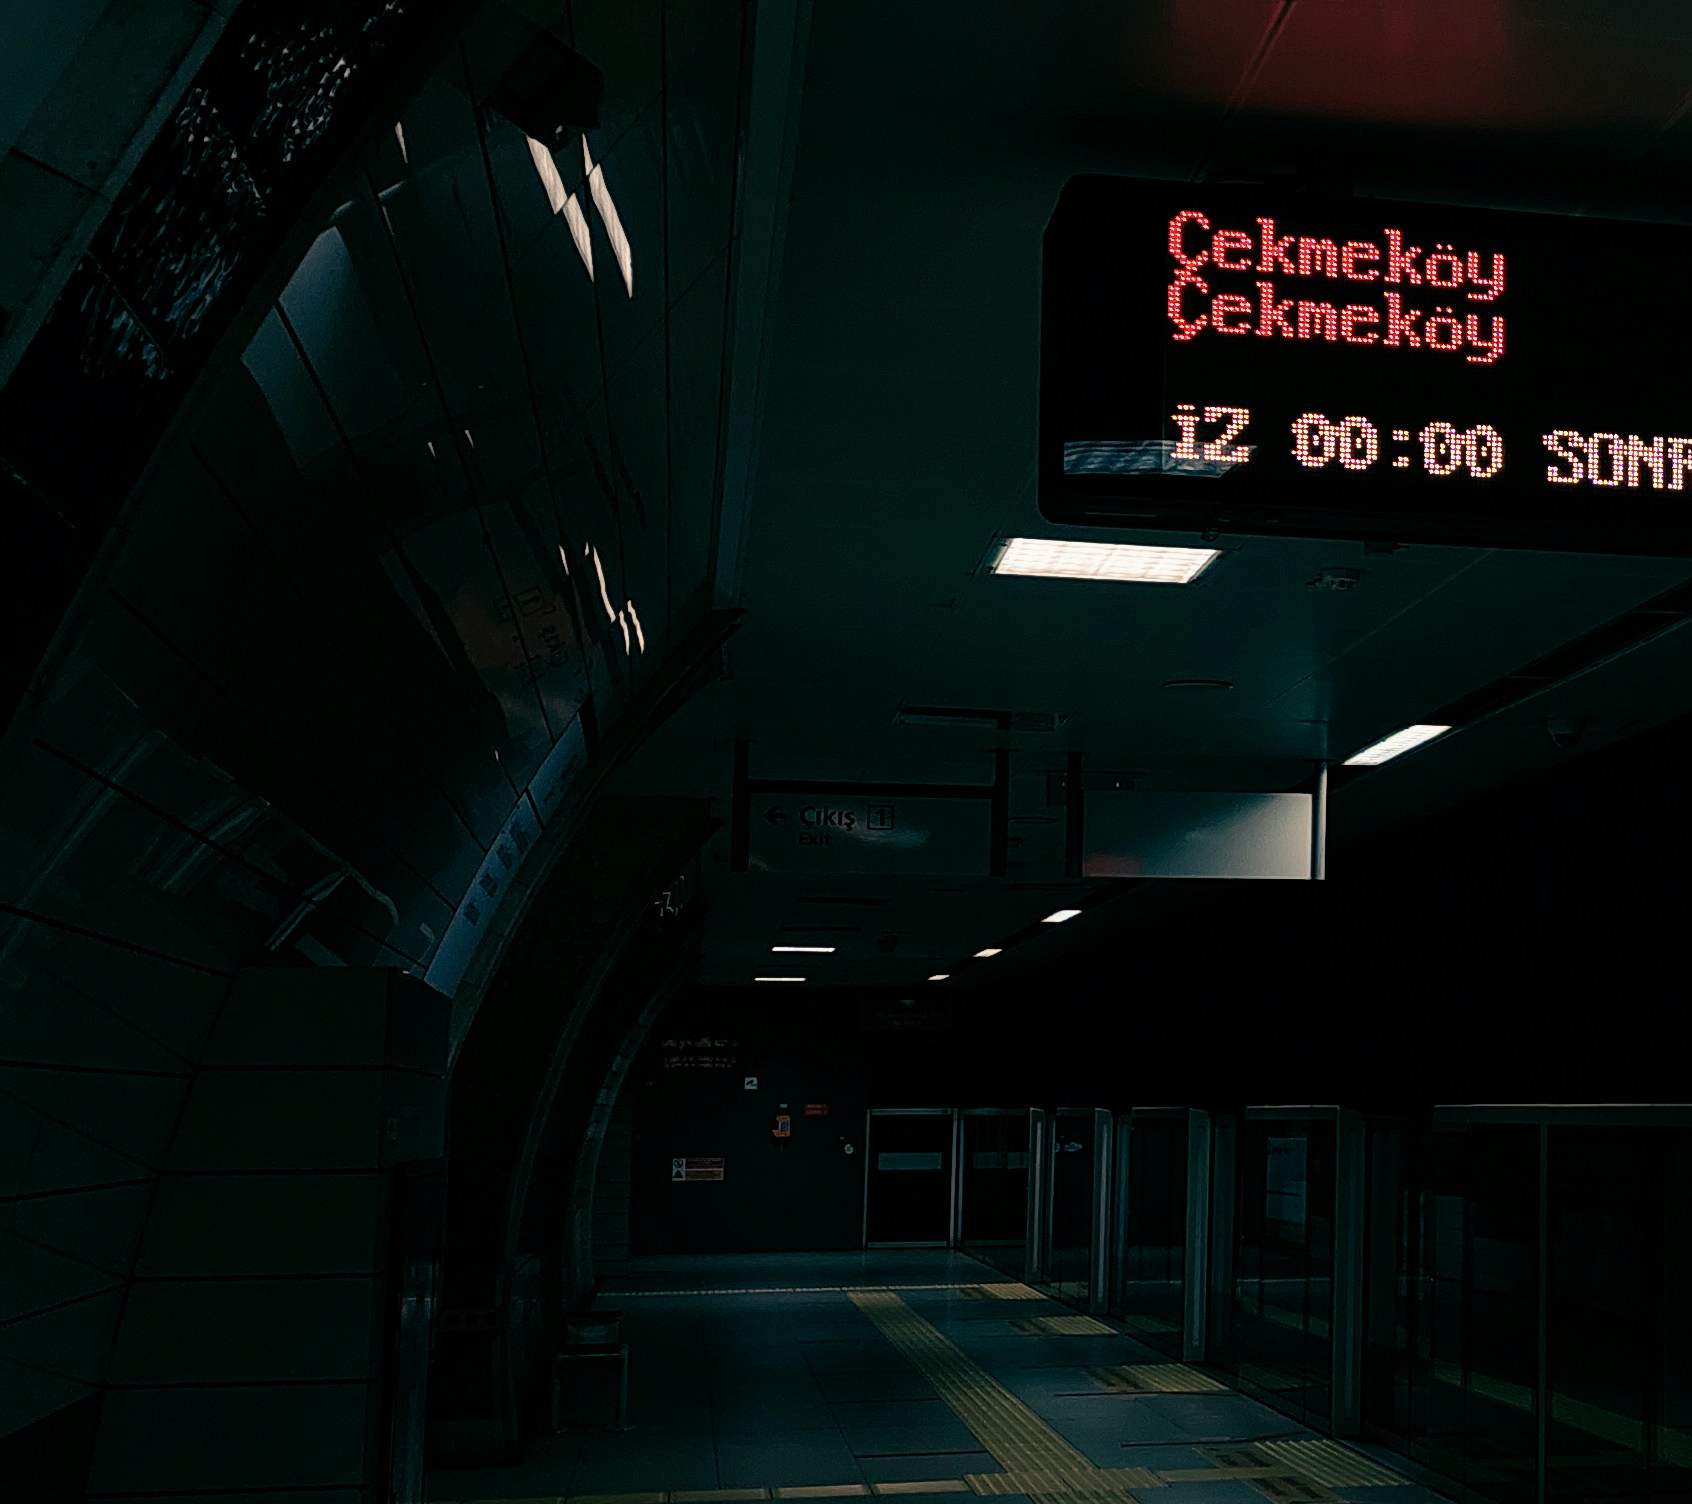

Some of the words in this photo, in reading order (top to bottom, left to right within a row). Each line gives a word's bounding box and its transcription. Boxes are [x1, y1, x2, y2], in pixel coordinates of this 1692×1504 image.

[1168, 210, 1506, 301] Çekmeköy
[1167, 270, 1506, 364] Çekmeköy
[1290, 412, 1504, 479] 00:00
[799, 804, 856, 832] Çıkış
